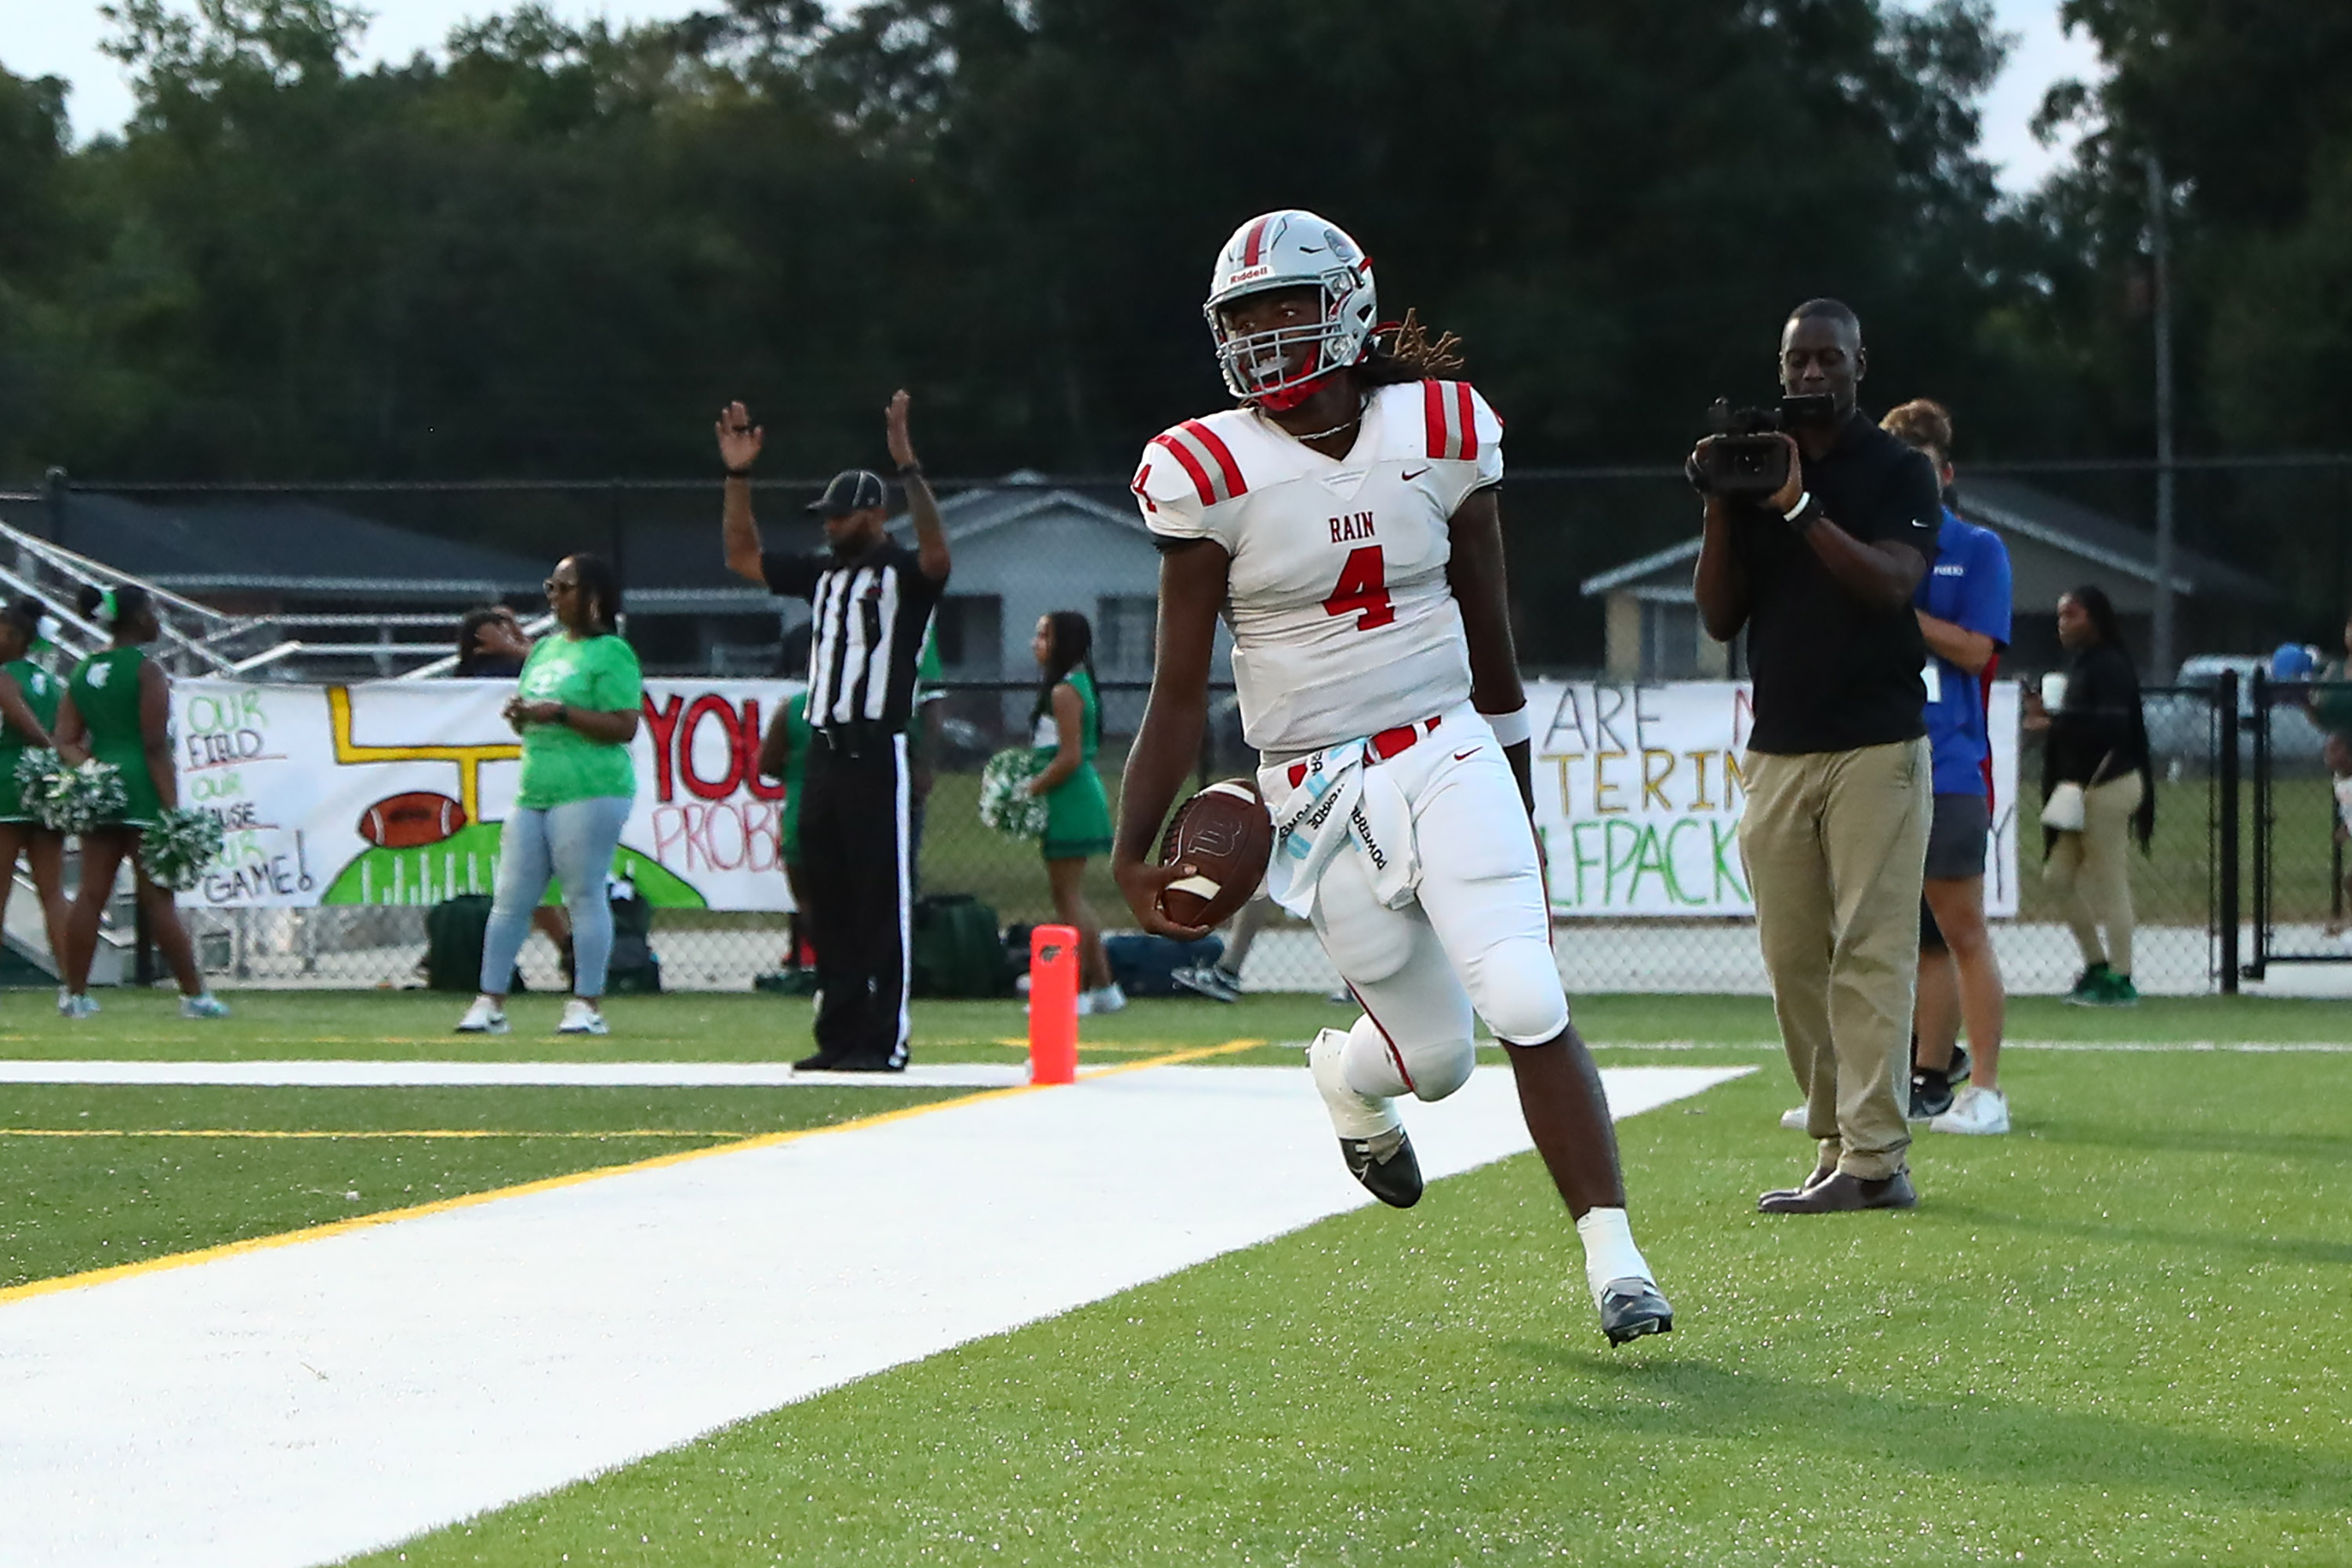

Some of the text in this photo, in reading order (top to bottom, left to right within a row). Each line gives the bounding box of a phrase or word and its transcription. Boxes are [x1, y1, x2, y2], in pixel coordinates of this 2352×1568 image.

[1230, 266, 1268, 285] Riddell
[1329, 511, 1375, 543] RAIN
[1321, 545, 1395, 631] 4
[187, 689, 269, 734] OUR
[1541, 686, 1664, 751] ARE
